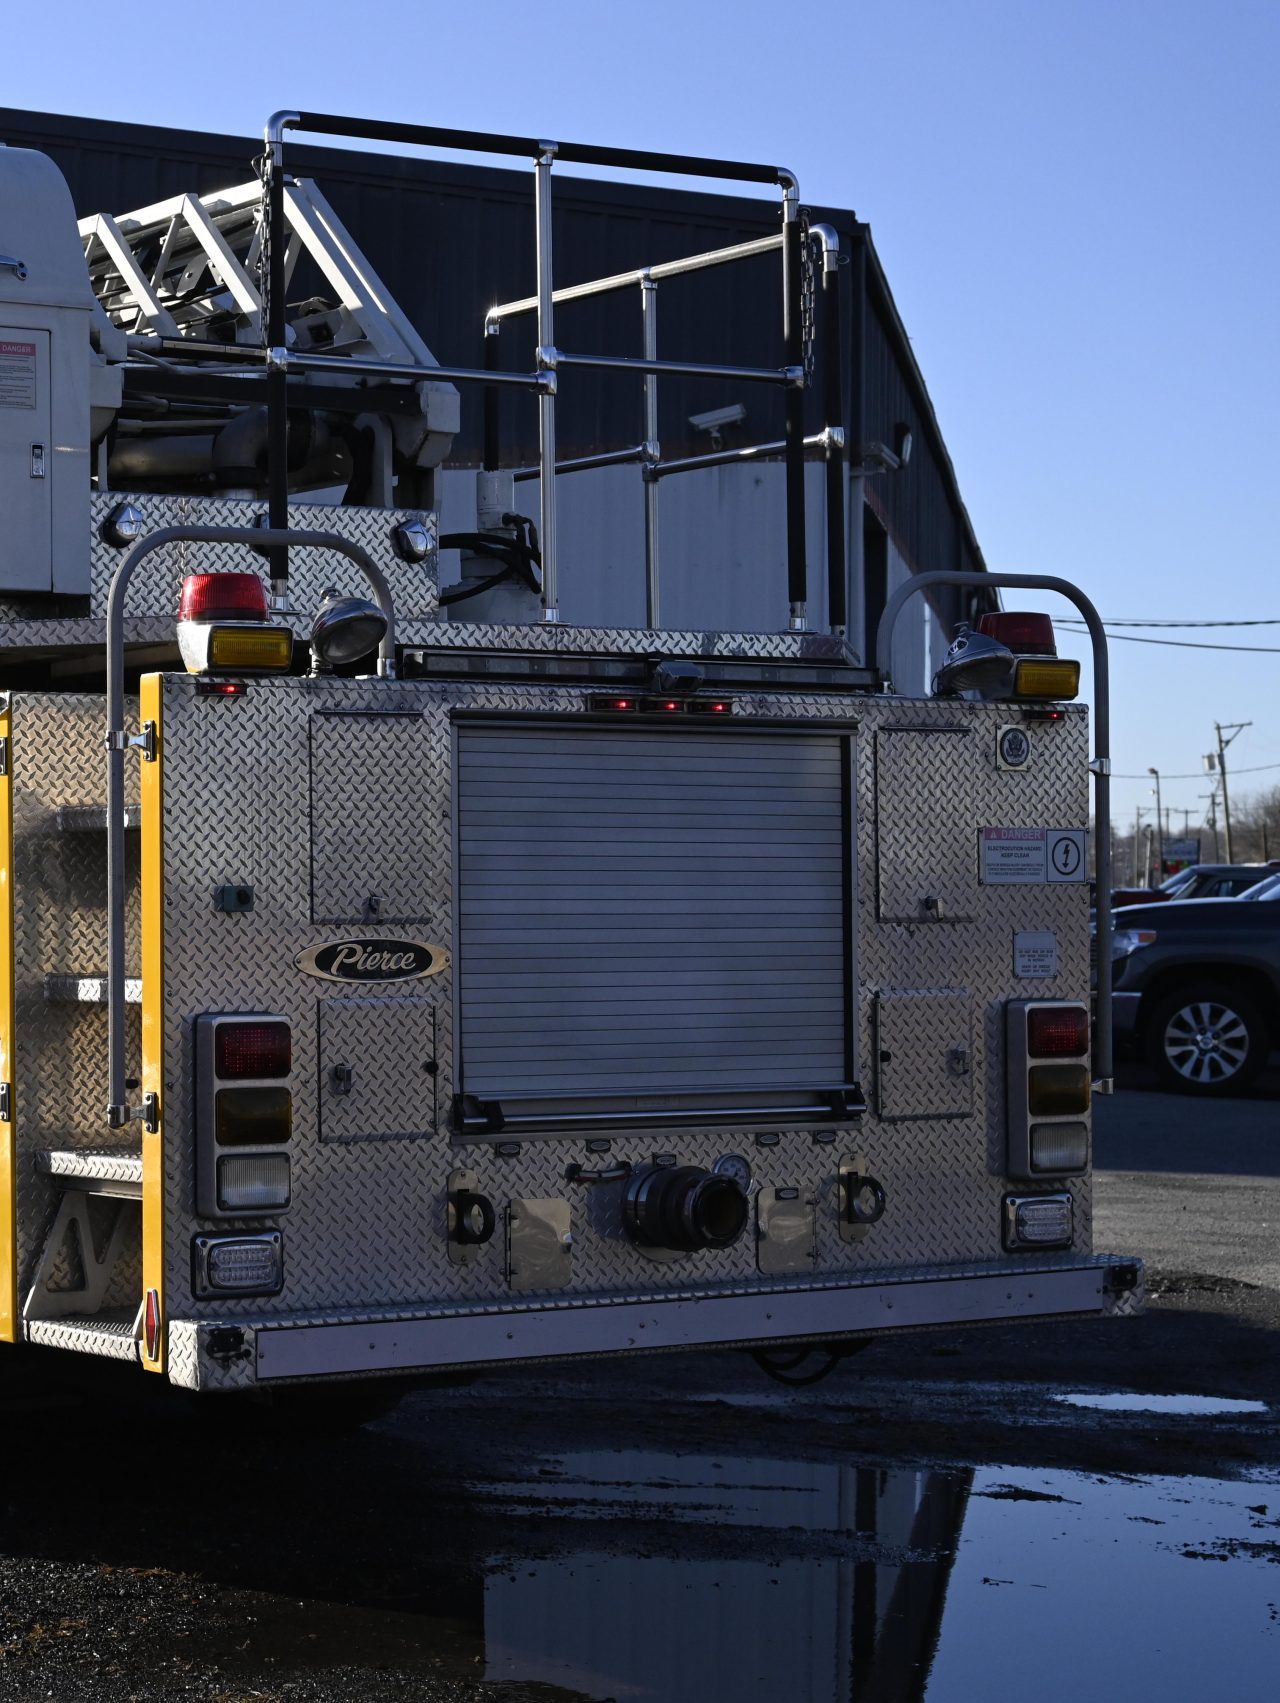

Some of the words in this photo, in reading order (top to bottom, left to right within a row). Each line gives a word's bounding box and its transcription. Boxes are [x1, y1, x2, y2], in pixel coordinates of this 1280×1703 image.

[2, 344, 31, 353] DANGER
[1001, 829, 1041, 840] DANGER
[330, 943, 416, 976] Pierce
